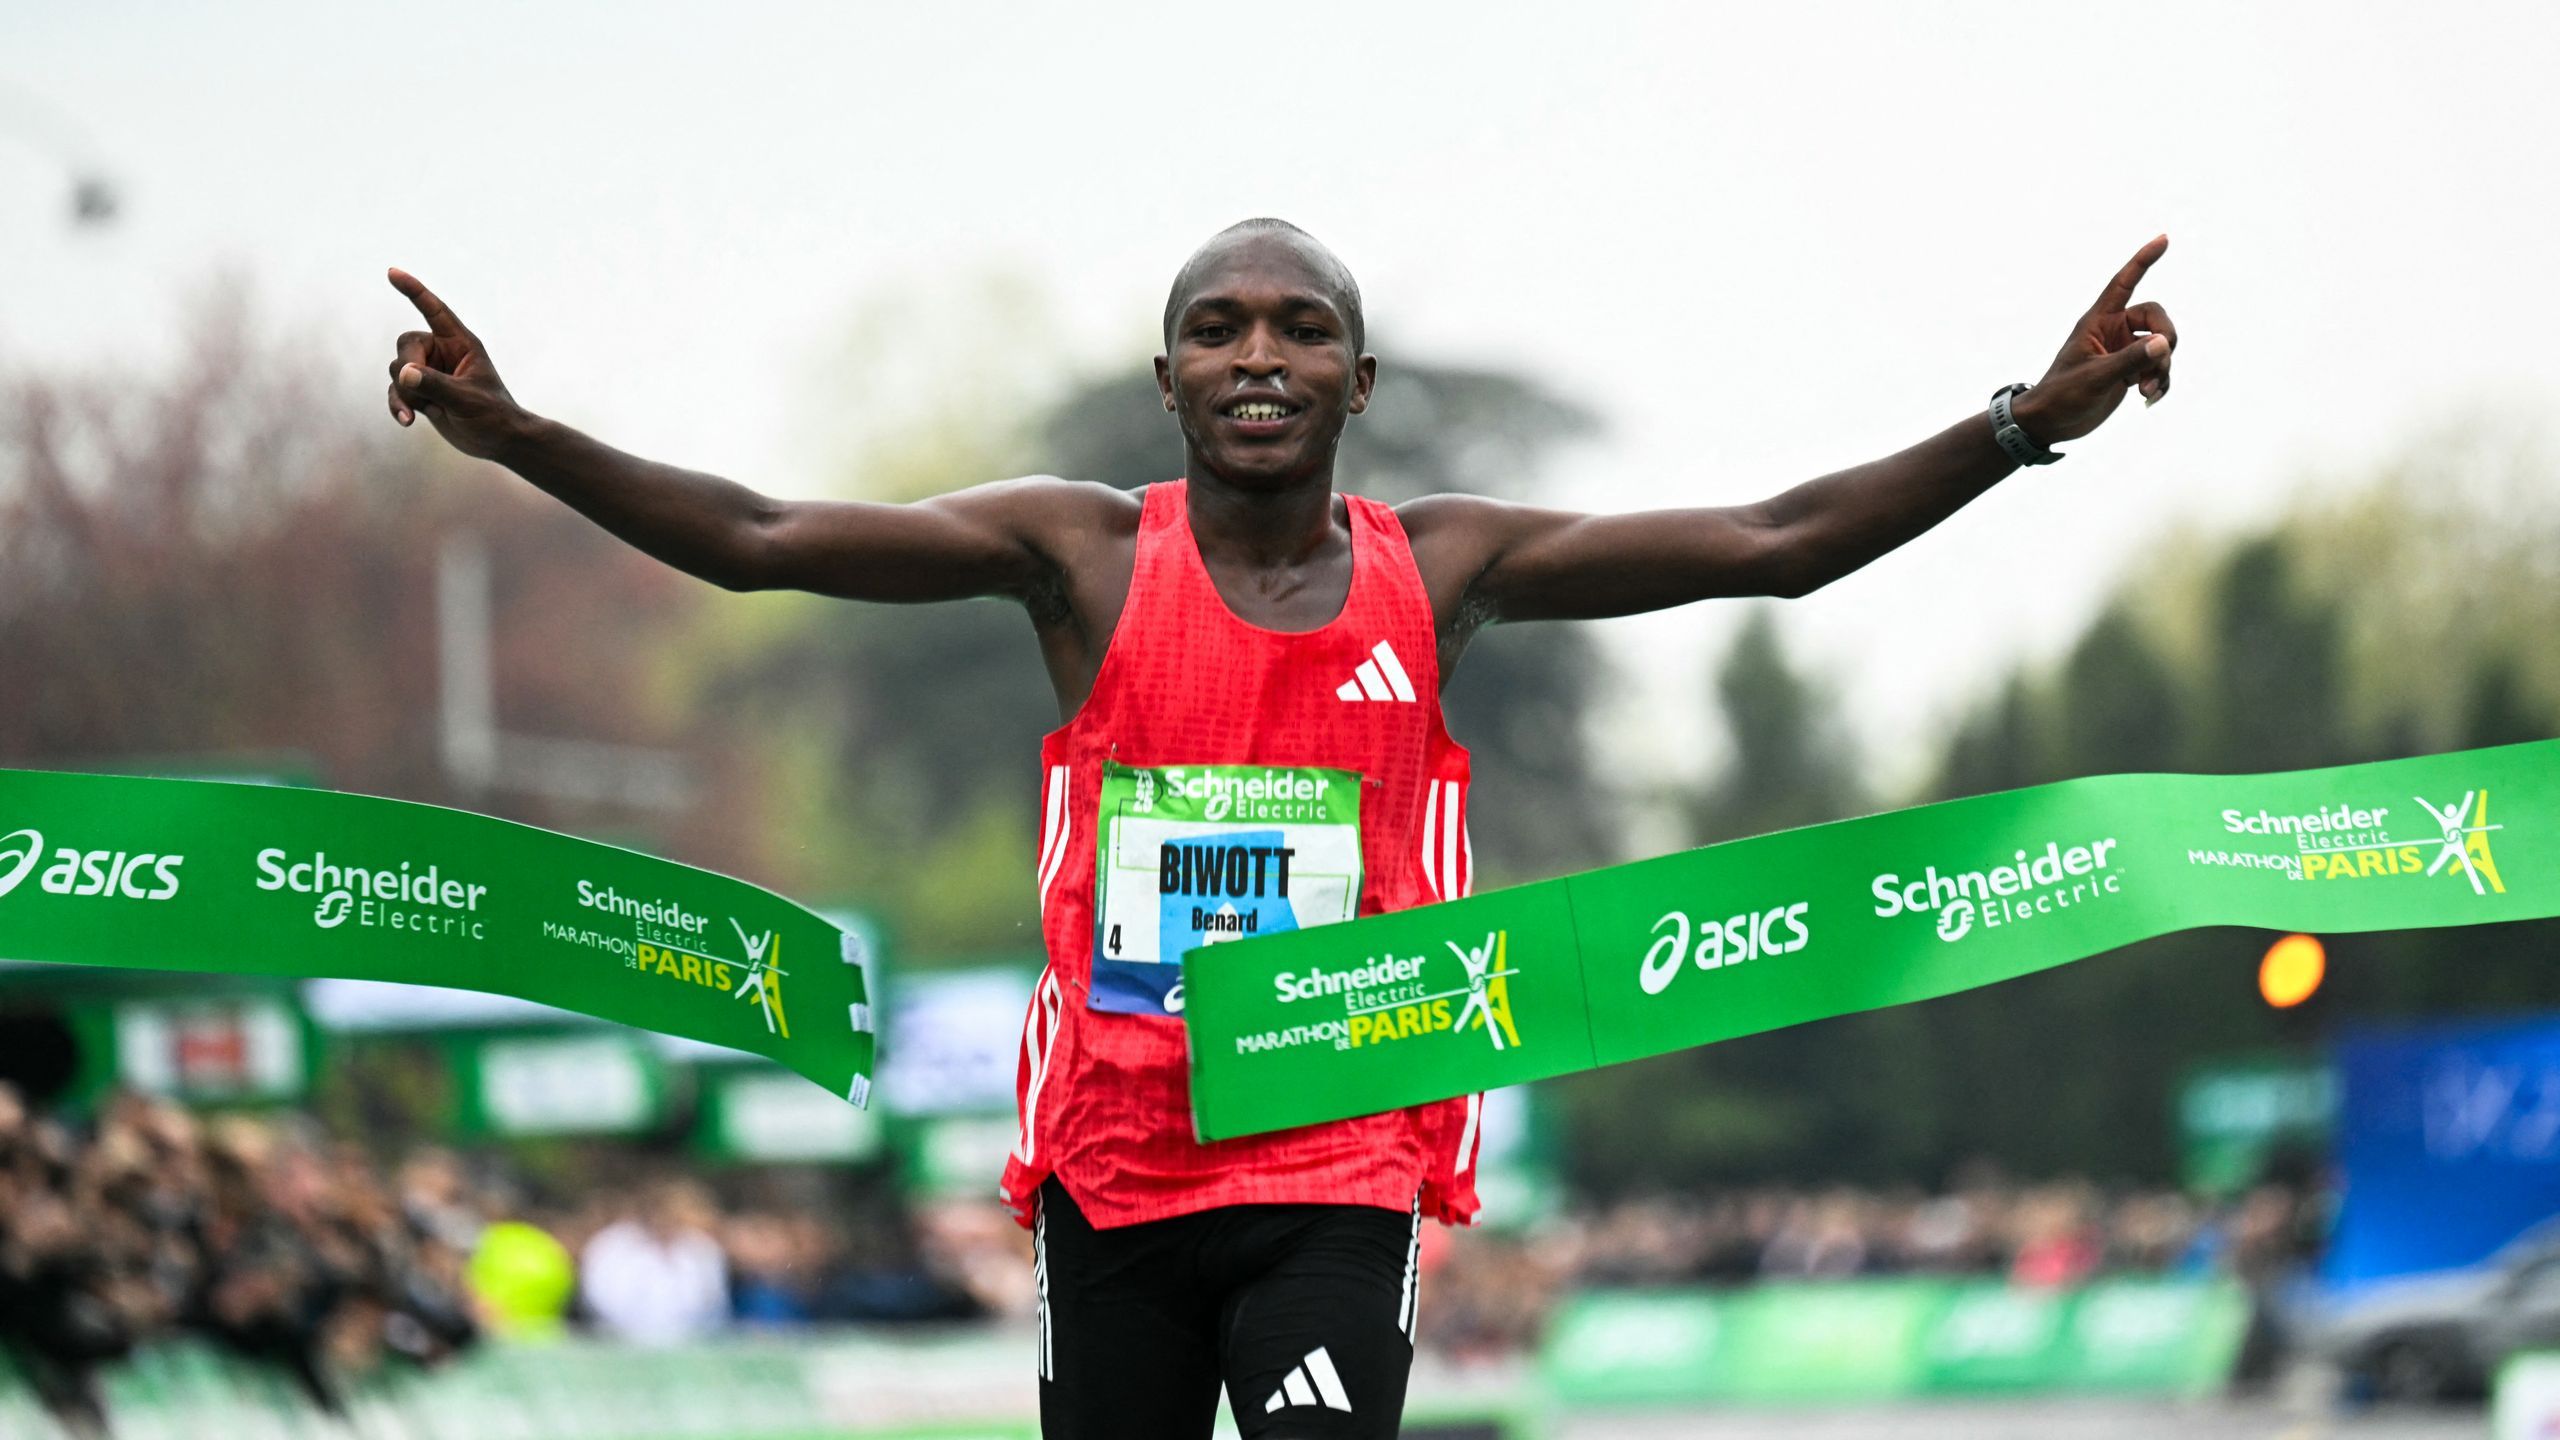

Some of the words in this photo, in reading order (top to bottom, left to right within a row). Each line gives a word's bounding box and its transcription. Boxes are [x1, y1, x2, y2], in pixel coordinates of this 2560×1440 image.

[1165, 769, 1329, 801] Schneider
[1236, 800, 1327, 820] Electric
[2221, 803, 2389, 835] Schneider
[2297, 830, 2390, 850] Electric
[256, 848, 487, 911] Schneider
[1159, 844, 1295, 898] BIWOTT
[1871, 837, 2117, 918] Schneider
[2188, 849, 2300, 871] MARATHON
[2287, 868, 2304, 881] DE
[2302, 846, 2424, 880] PARIS
[577, 879, 709, 934] Schneider
[1983, 872, 2121, 928] Electric
[360, 901, 485, 940] Electric
[636, 920, 707, 952] Electric
[1191, 907, 1258, 932] Benard
[543, 921, 637, 958] MARATHON
[625, 956, 638, 969] DE
[637, 943, 732, 991] PARIS
[1108, 924, 1123, 955] 4
[1274, 953, 1426, 1003] Schneider
[1345, 981, 1426, 1011] Electric
[1236, 1019, 1350, 1054] MARATHON
[1334, 1037, 1351, 1051] DE
[1349, 999, 1453, 1048] PARIS
